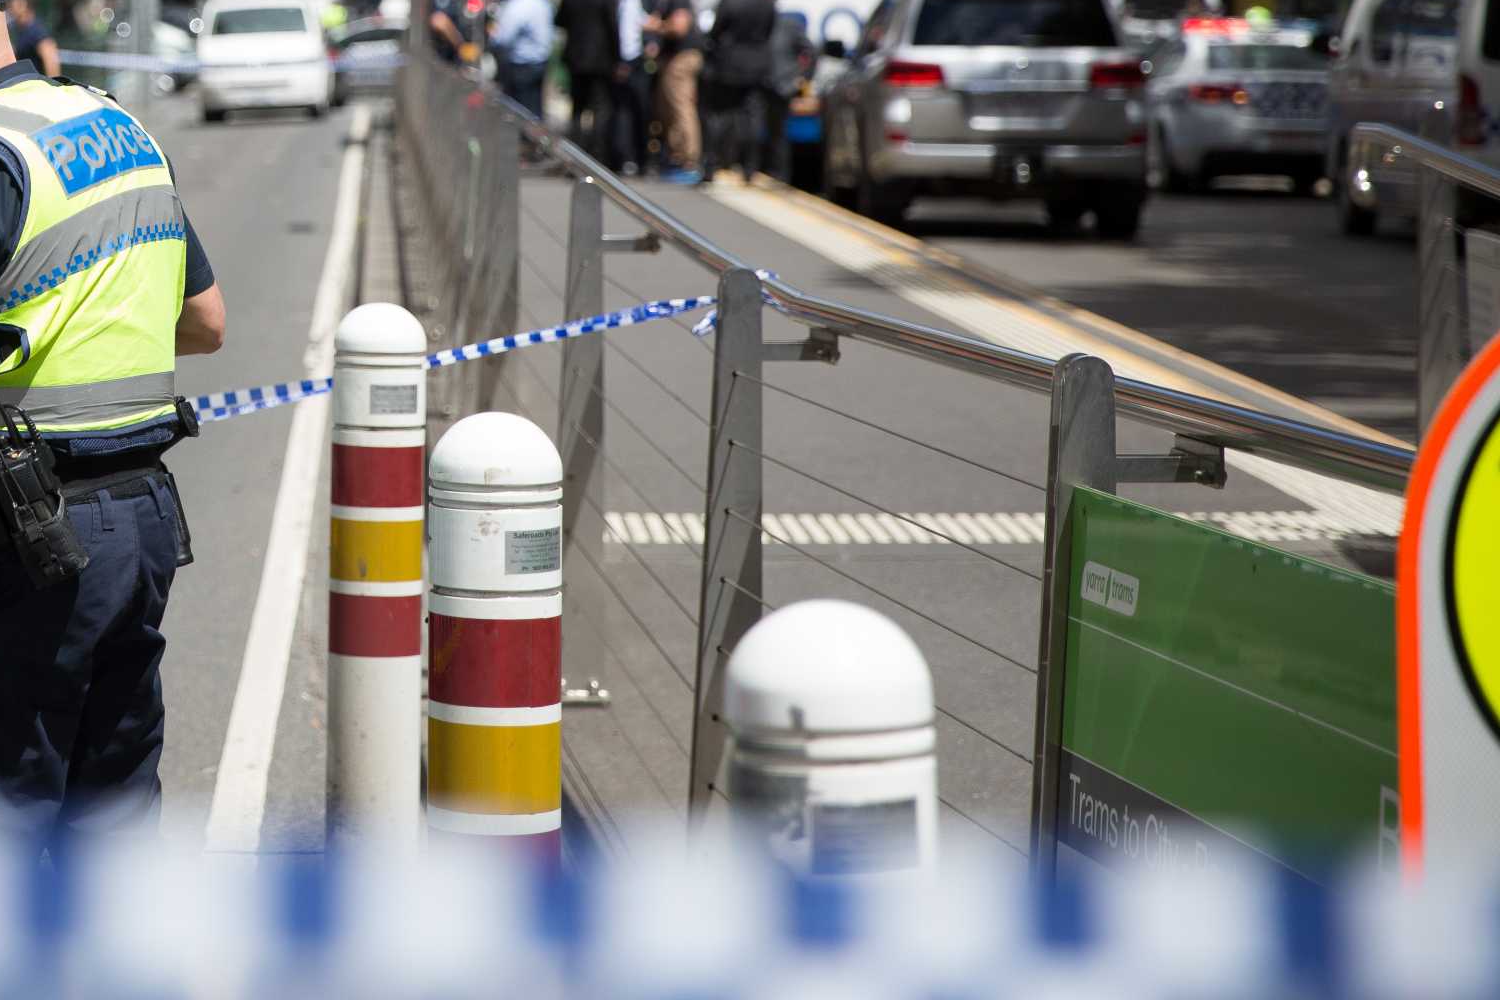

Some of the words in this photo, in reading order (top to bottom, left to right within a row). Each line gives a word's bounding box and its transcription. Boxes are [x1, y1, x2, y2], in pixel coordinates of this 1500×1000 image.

[46, 118, 154, 181] Police
[1069, 773, 1118, 849] Trams
[1123, 805, 1140, 859] to
